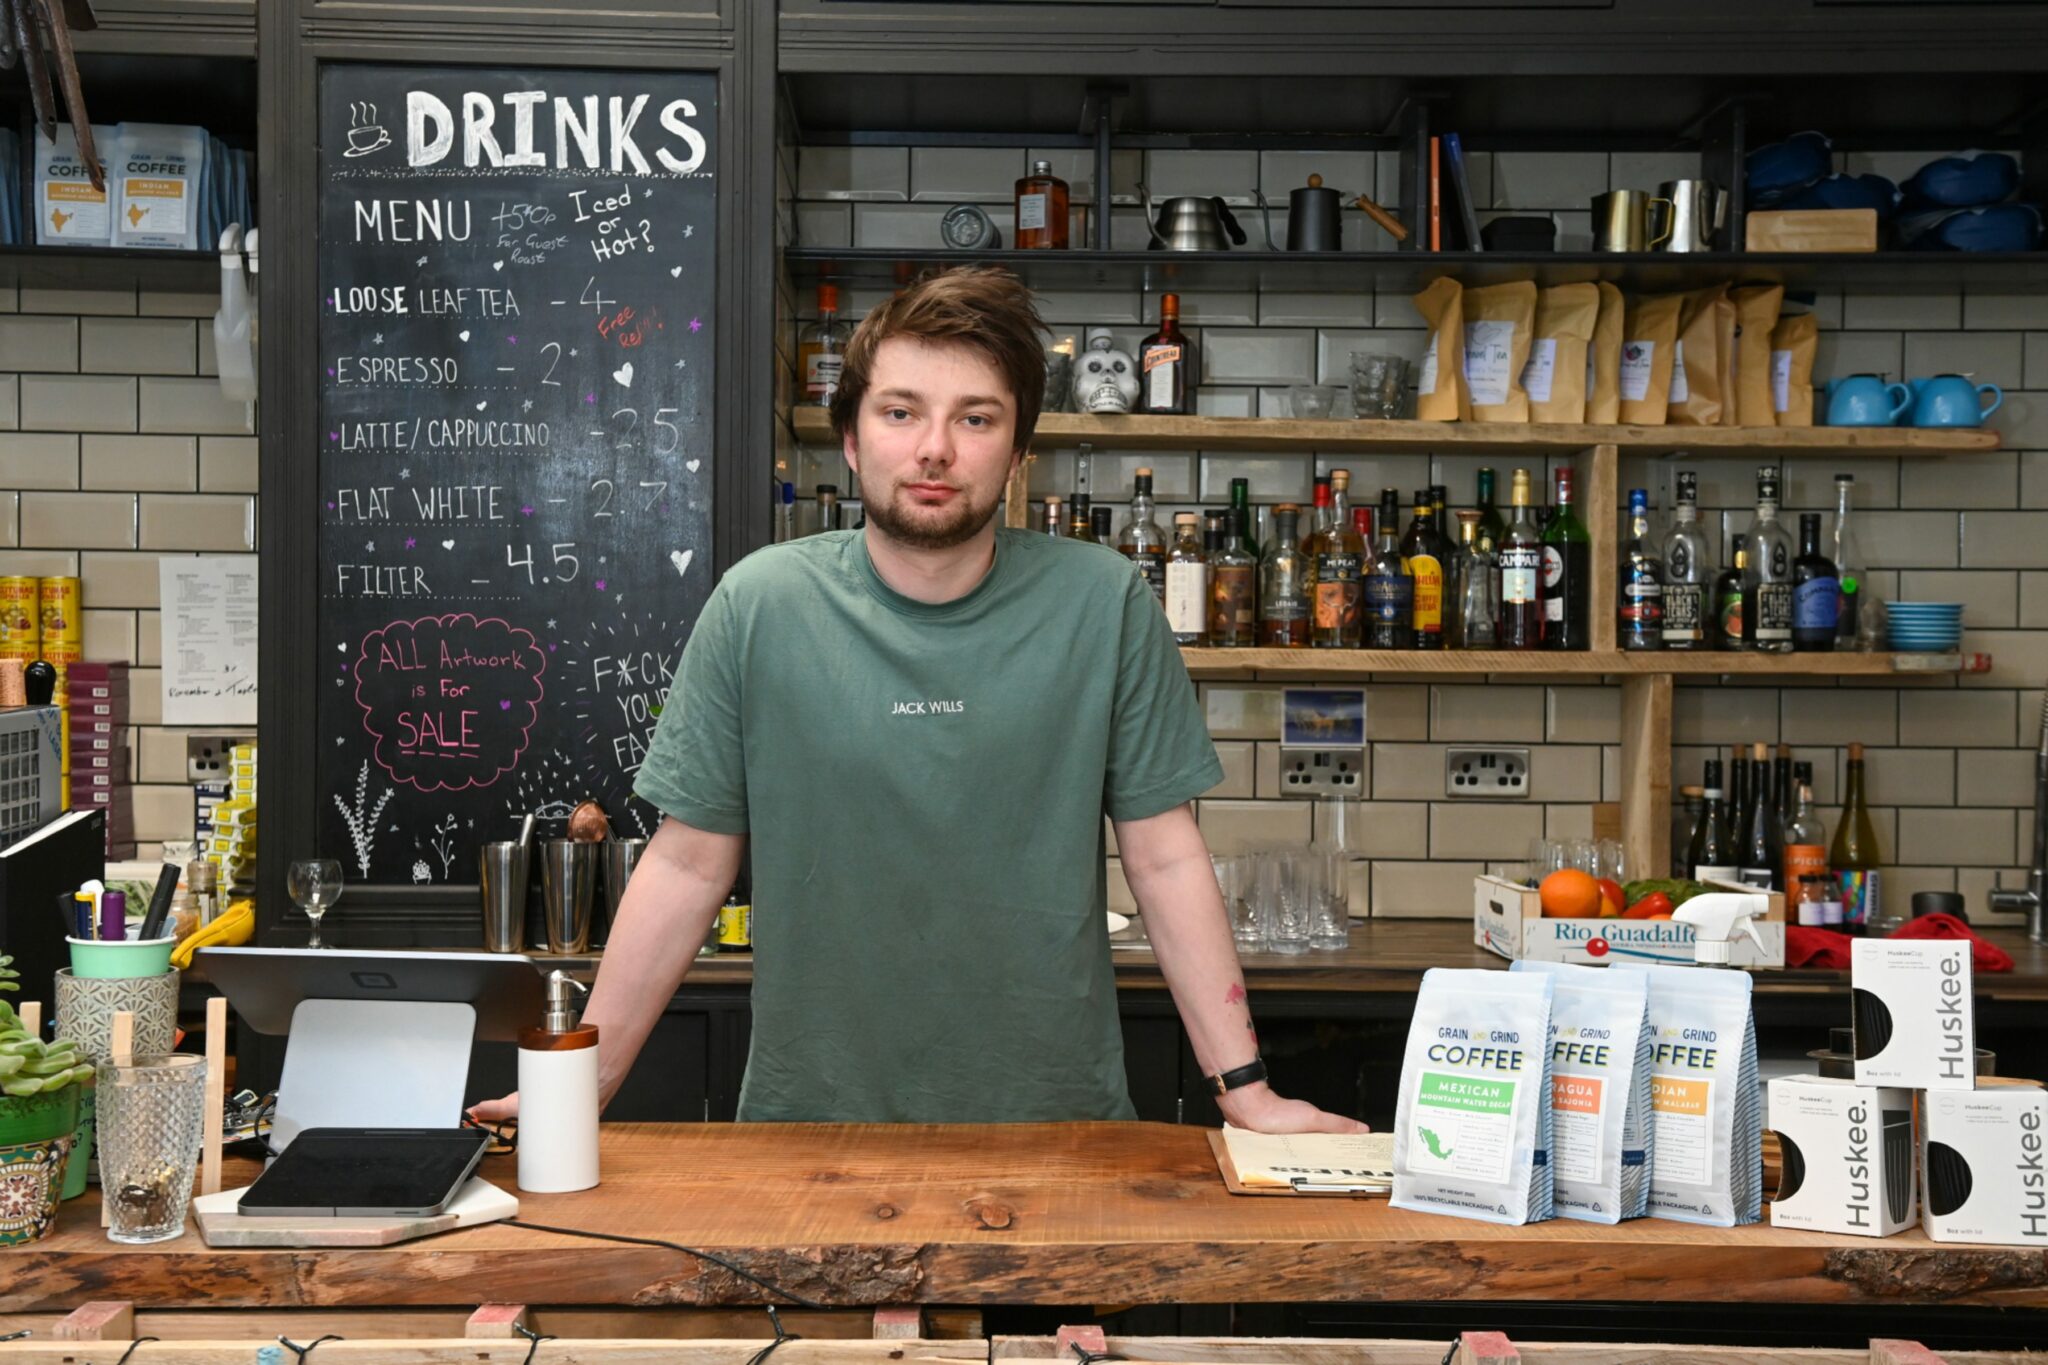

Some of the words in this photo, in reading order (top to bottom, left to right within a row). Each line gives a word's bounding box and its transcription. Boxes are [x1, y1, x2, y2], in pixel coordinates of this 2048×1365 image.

[407, 90, 706, 175] DRINKS
[48, 165, 107, 179] COFFE
[126, 161, 187, 175] COFFEE
[139, 182, 170, 190] INDIAN
[568, 184, 632, 223] Iced
[355, 199, 471, 242] MENU
[598, 216, 621, 235] or
[591, 219, 655, 263] Hot?
[334, 285, 409, 314] LOOSE
[419, 287, 472, 314] LEAF
[476, 287, 520, 317] TEA
[579, 275, 617, 315] 4
[597, 305, 637, 340] Free
[337, 356, 458, 384] ESPRESSO
[540, 342, 561, 386] 2
[341, 417, 550, 451] LATTE/CAPPUCCINO
[338, 486, 394, 520] FLAT
[412, 486, 504, 520] WHITE
[591, 479, 668, 518] 2.7
[338, 564, 432, 595] FILTER
[506, 542, 579, 585] 4.5
[1499, 554, 1540, 567] CAMPARI
[378, 638, 427, 672] ALL
[440, 639, 526, 671] Artwork
[412, 683, 426, 698] is
[440, 678, 471, 698] For
[891, 701, 926, 714] JACK
[928, 700, 964, 713] WILLS
[398, 710, 480, 748] SALE
[1555, 922, 1592, 941] Rio
[1936, 951, 1964, 1080] Huskee.
[1438, 1026, 1468, 1041] GRAIN
[1490, 1030, 1520, 1044] GRIND
[1580, 1027, 1611, 1040] GRIND
[1682, 1027, 1717, 1043] GRIND
[1427, 1043, 1523, 1071] COFFEE
[1552, 1041, 1610, 1066] FFEE
[1650, 1043, 1718, 1069] FFEE
[1420, 1092, 1461, 1105] MOUNTAIN
[1462, 1097, 1487, 1107] WATER
[1438, 1081, 1500, 1098] MEXICAN
[1552, 1081, 1594, 1097] RAGUA
[1652, 1084, 1687, 1097] DIAN
[1844, 1099, 1871, 1228] Huskee.
[2016, 1105, 2048, 1238] Huskee.
[1461, 1201, 1495, 1212] PACKAGING
